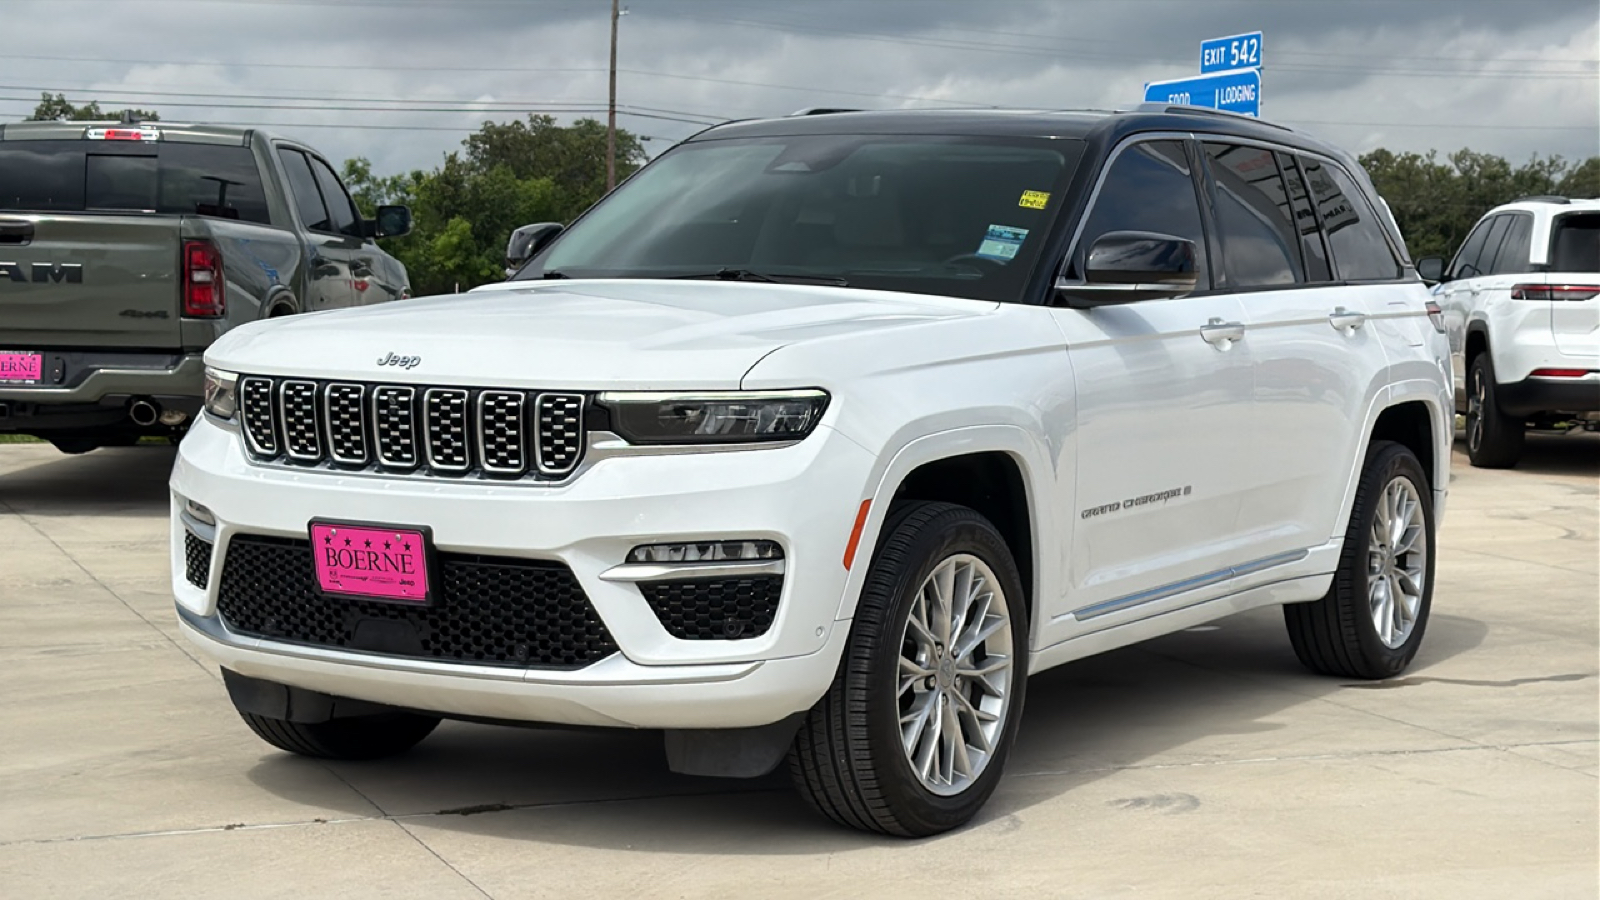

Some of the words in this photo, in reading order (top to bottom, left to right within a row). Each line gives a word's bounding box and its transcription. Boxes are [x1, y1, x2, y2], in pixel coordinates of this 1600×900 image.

[1204, 46, 1226, 66] EXIT
[1230, 38, 1258, 66] 542
[1220, 84, 1255, 105] LODGING
[377, 352, 421, 370] Jeep
[1081, 501, 1121, 519] GRAND
[1123, 487, 1182, 507] CHEROKEE
[325, 546, 416, 575] BOERNE
